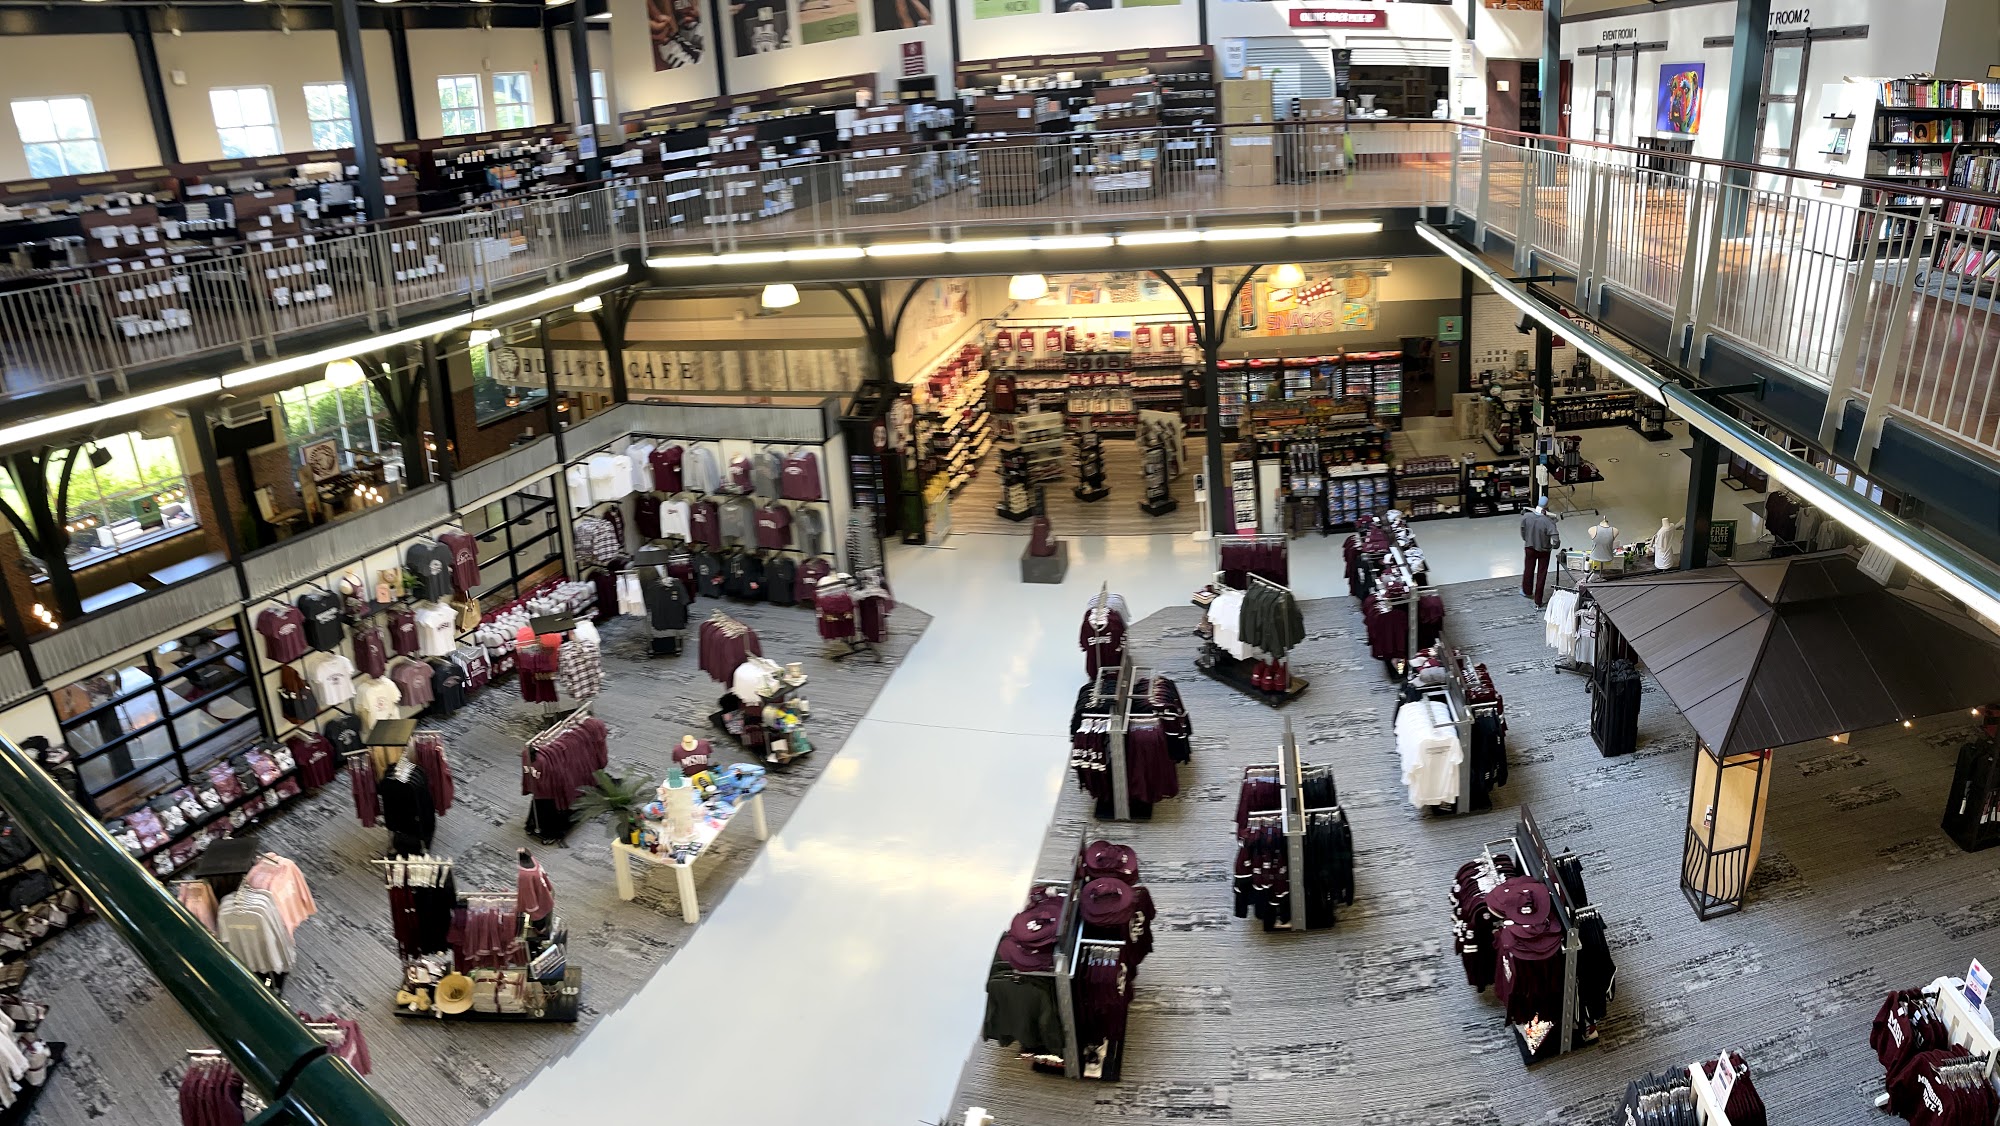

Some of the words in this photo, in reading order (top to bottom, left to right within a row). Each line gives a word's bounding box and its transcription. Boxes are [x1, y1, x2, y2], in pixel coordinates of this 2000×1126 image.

[1776, 10, 1802, 24] ROOM
[1803, 9, 1809, 22] 2
[1602, 30, 1618, 40] EVENT
[1618, 28, 1633, 39] ROOM
[1266, 310, 1335, 330] SNACKS
[627, 362, 693, 379] CAFE
[1710, 526, 1729, 536] FREE
